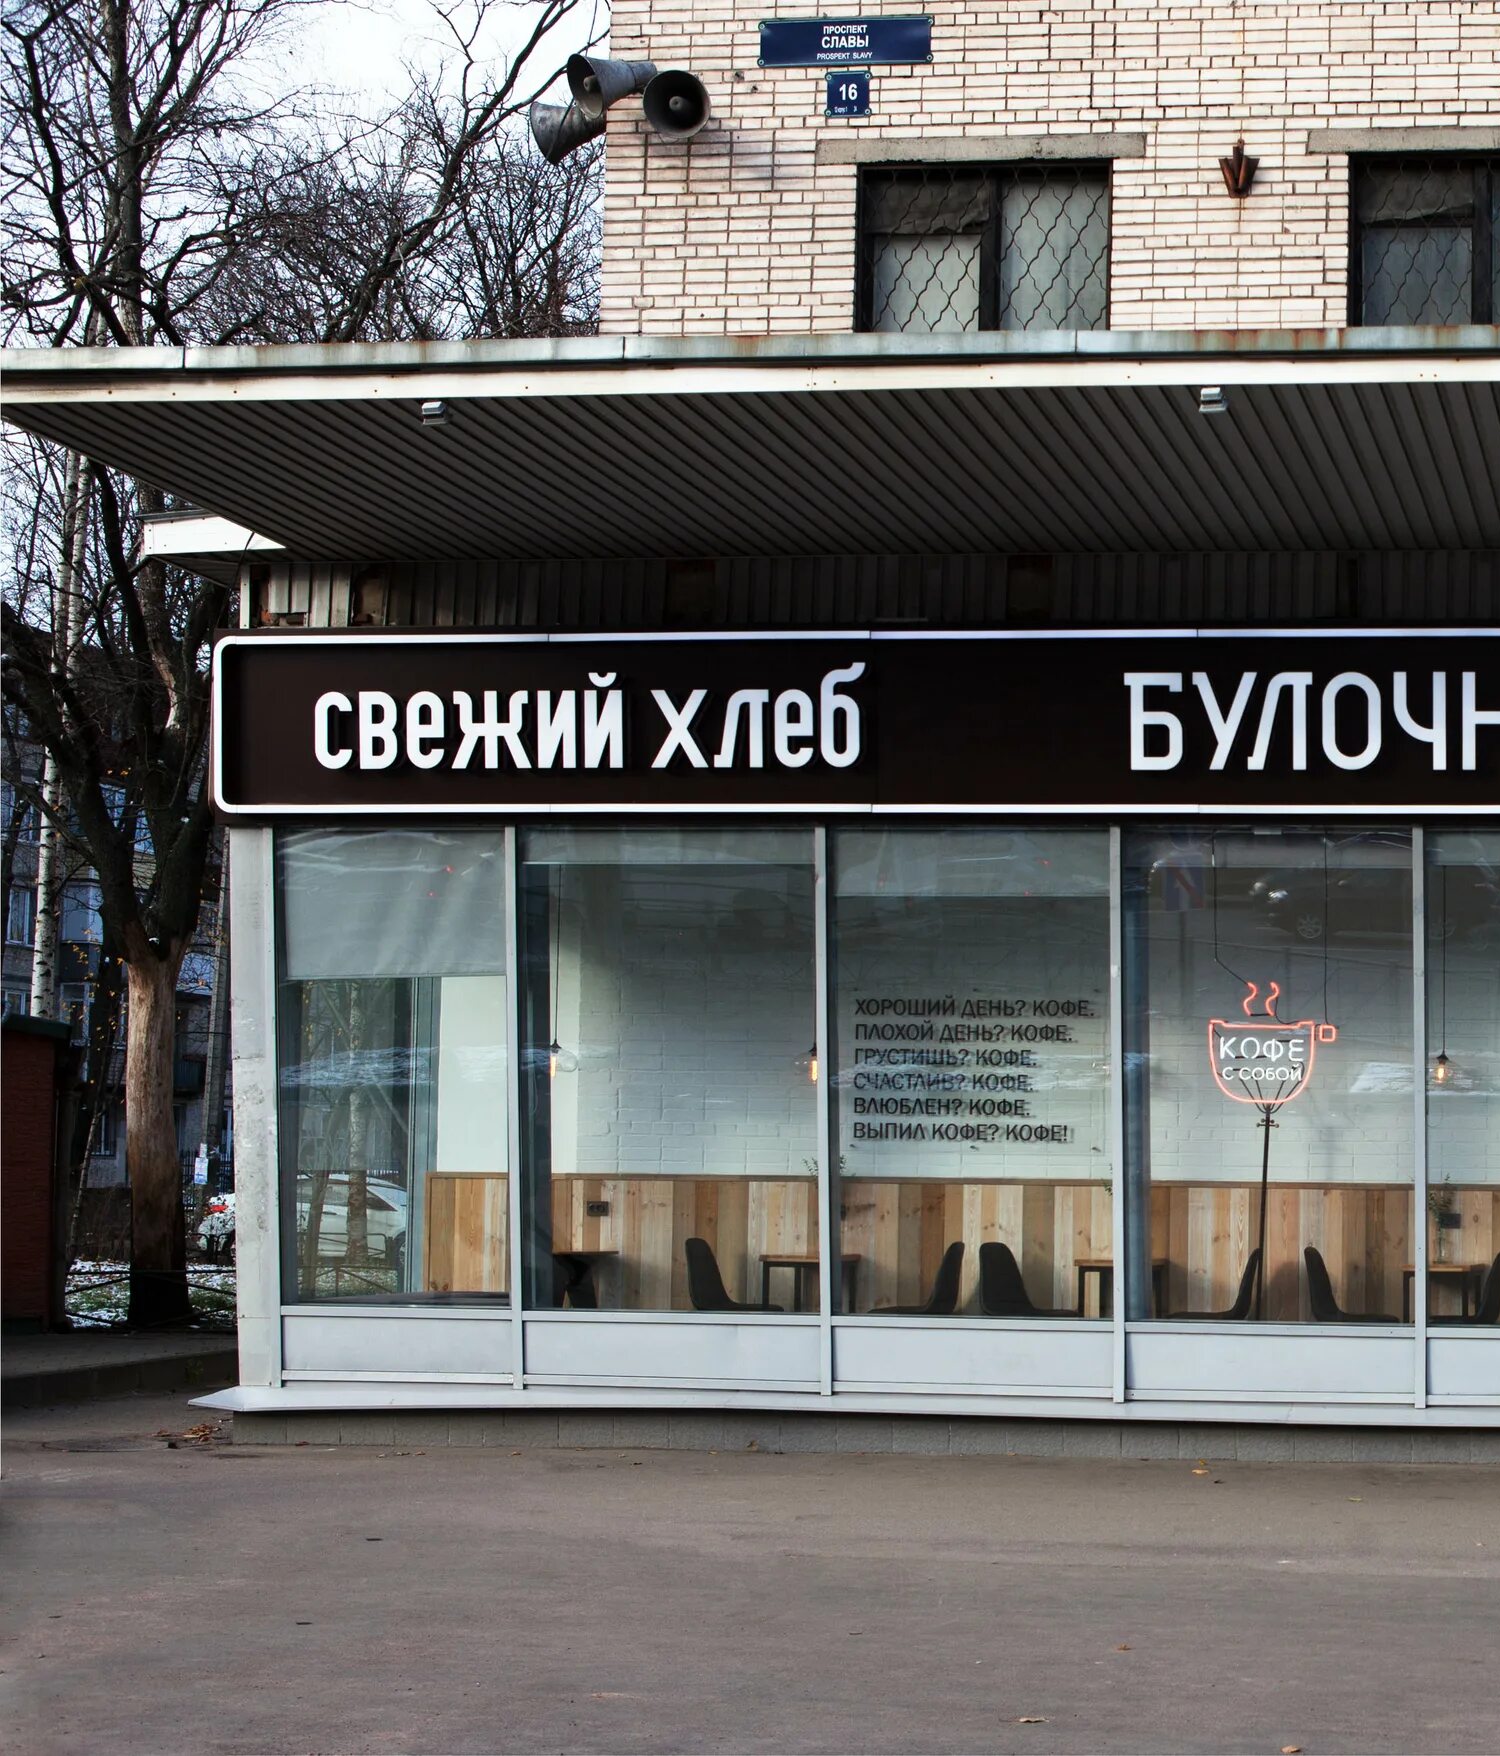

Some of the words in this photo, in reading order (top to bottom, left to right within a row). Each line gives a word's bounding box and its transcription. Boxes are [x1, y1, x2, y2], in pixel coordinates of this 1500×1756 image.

[823, 25, 867, 34] ПРОСПЕКТ
[821, 35, 869, 48] СЛАВЫ
[816, 52, 850, 60] PROSPEKT
[852, 51, 873, 59] SLAVY
[839, 84, 858, 100] 16
[855, 995, 955, 1016] ХОРОШИЙ
[961, 999, 1026, 1018] ДЕНЬ?
[1033, 999, 1094, 1016] КОФЕ.
[855, 1020, 933, 1040] ПЛОХОЙ
[939, 1024, 1004, 1043] ДЕНЬ?
[1011, 1024, 1073, 1041] КОФЕ.
[855, 1048, 969, 1065] ГРУСТИШЬ?
[976, 1049, 1036, 1066] КОФЕ.
[1220, 1036, 1304, 1061] КОФЕ
[854, 1072, 966, 1090] СЧАСТЛИВ?
[973, 1074, 1033, 1091] КОФЕ.
[854, 1097, 962, 1115] ВЛЮБЛЕН?
[969, 1099, 1030, 1116] КОФЕ.
[854, 1122, 925, 1139] ВЫПИЛ
[932, 1123, 999, 1140] КОФЕ?
[1006, 1124, 1067, 1141] КОФЕ!
